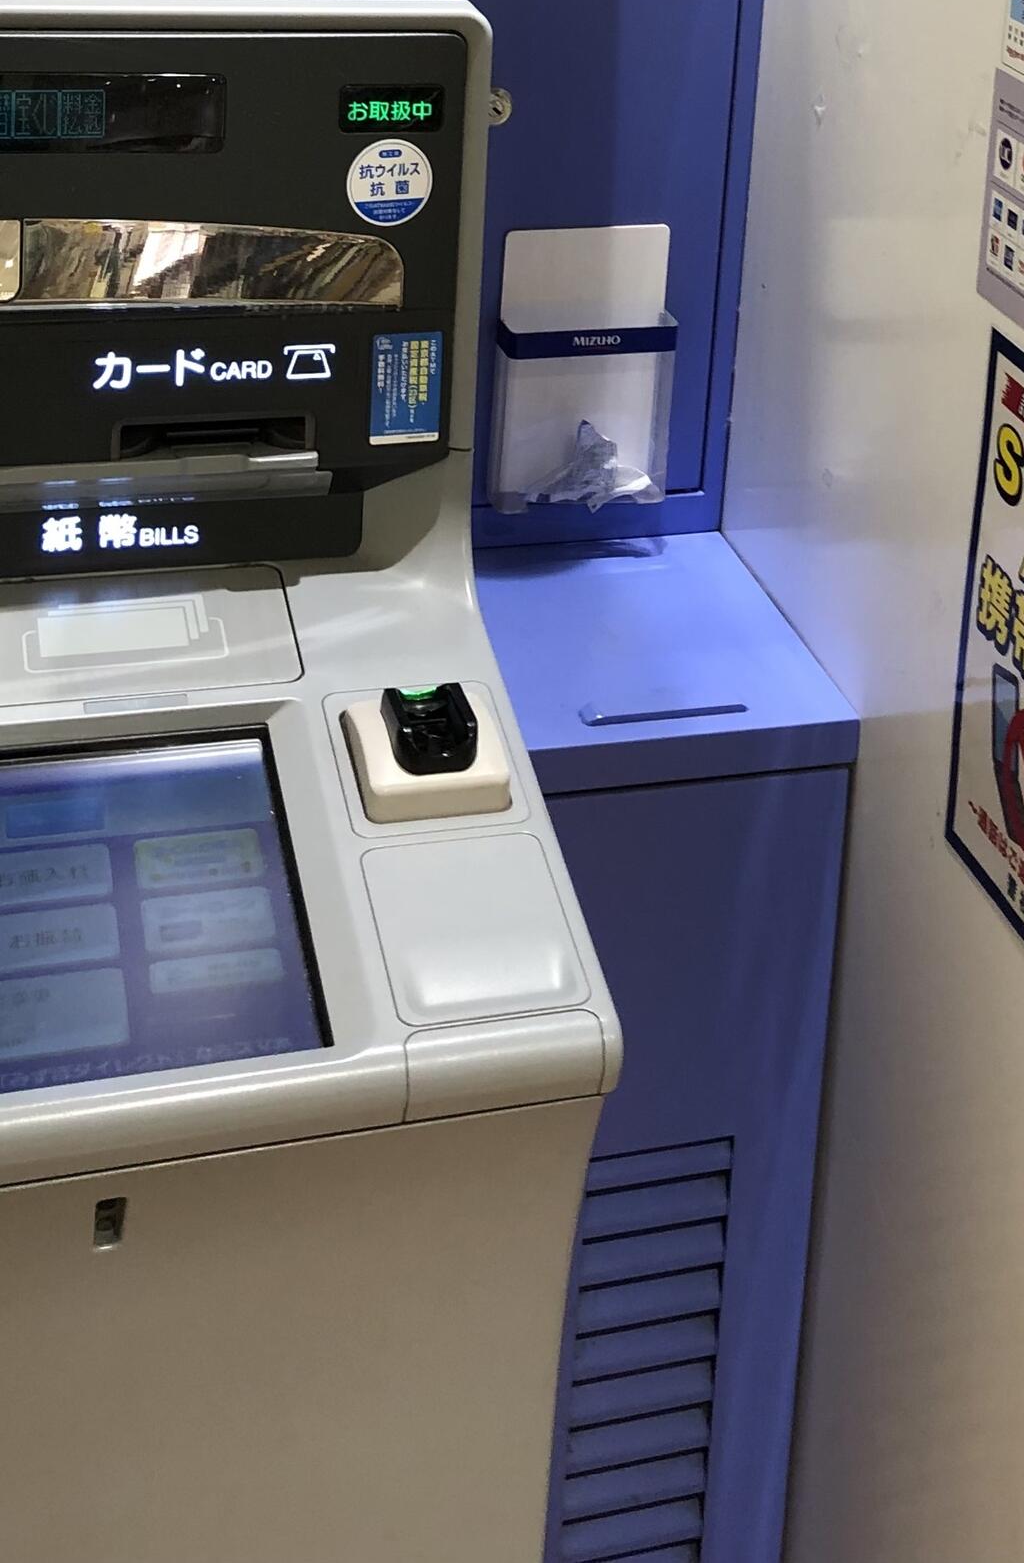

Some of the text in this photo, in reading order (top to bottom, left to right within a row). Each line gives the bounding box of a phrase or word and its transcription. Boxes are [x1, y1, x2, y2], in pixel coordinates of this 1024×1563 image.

[347, 100, 432, 121] お取扱中
[359, 162, 420, 180] 抗ウイルス
[370, 180, 410, 197] 抗菌
[573, 335, 621, 346] MIZUHO
[93, 348, 272, 390] カード CARD
[41, 513, 199, 553] 紙幣 BILLS
